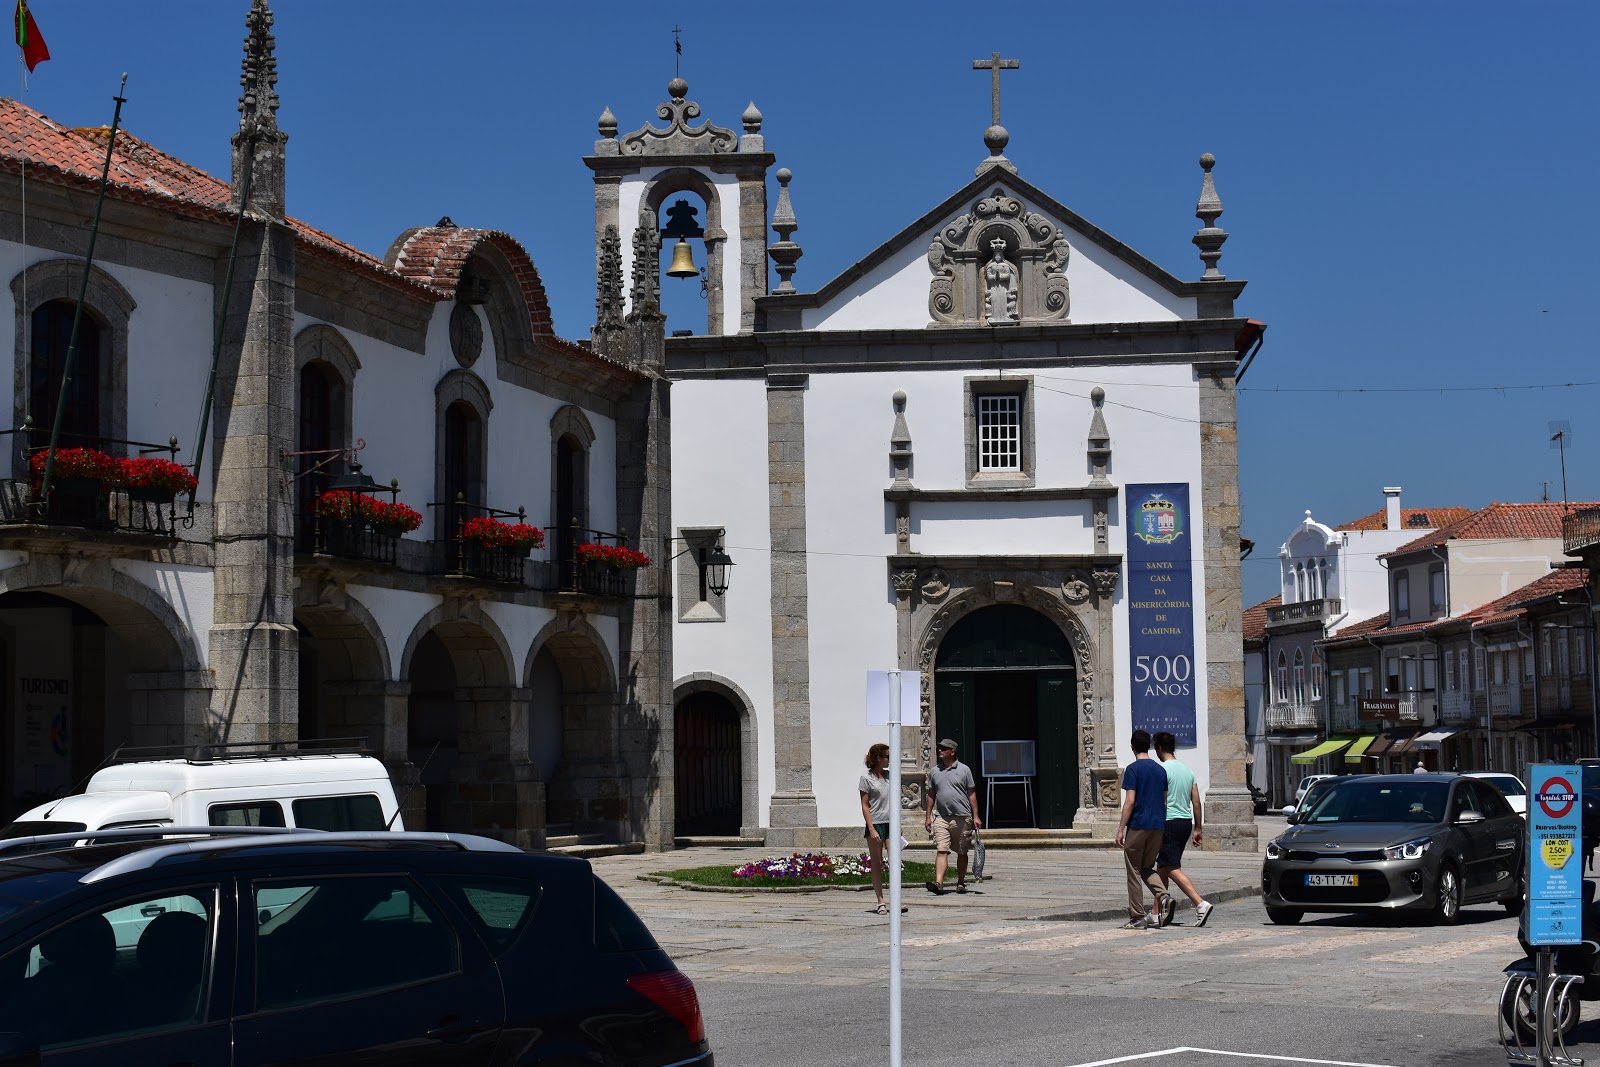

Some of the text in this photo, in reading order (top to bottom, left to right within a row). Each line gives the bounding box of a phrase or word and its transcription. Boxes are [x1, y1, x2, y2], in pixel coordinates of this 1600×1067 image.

[1131, 600, 1190, 609] MISERICÓRDIA
[1141, 627, 1181, 635] CAMINHA
[1134, 654, 1191, 682] 500
[20, 677, 69, 695] TURISMO
[1144, 683, 1190, 696] ANOS
